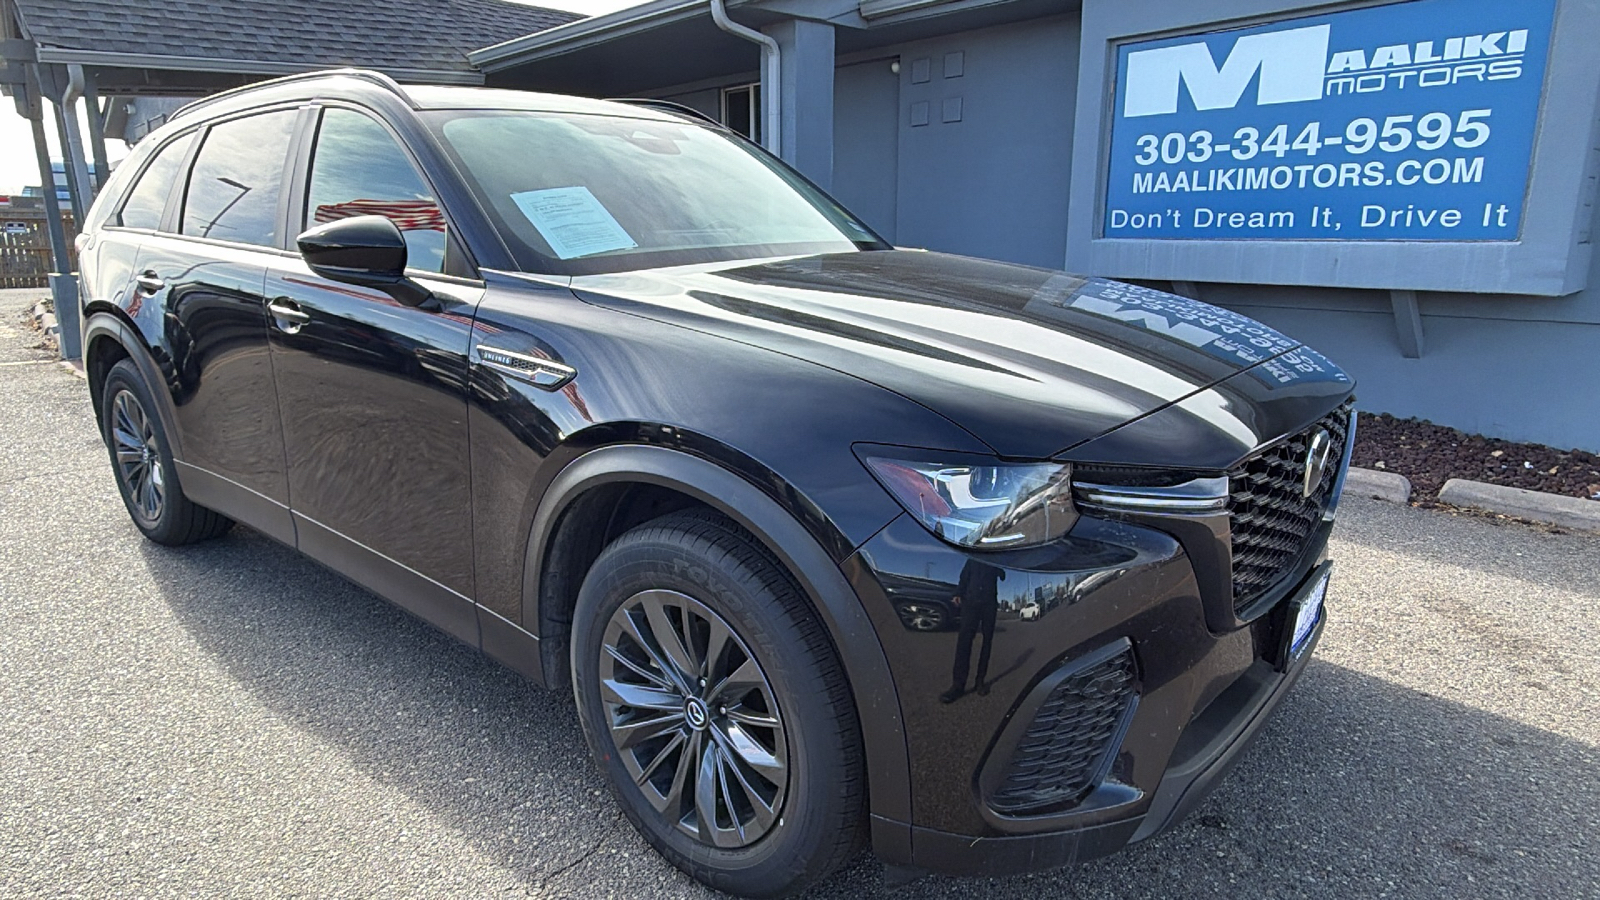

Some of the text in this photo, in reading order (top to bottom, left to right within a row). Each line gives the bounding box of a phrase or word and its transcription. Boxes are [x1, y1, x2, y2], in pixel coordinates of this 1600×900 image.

[1326, 60, 1523, 96] MOTORS
[1134, 109, 1492, 166] 303-344-9595
[1132, 157, 1485, 194] MAALIKIMOTORS.COM
[1111, 203, 1509, 231] Don't Dream It, Drive It
[673, 558, 744, 612] TOYO
